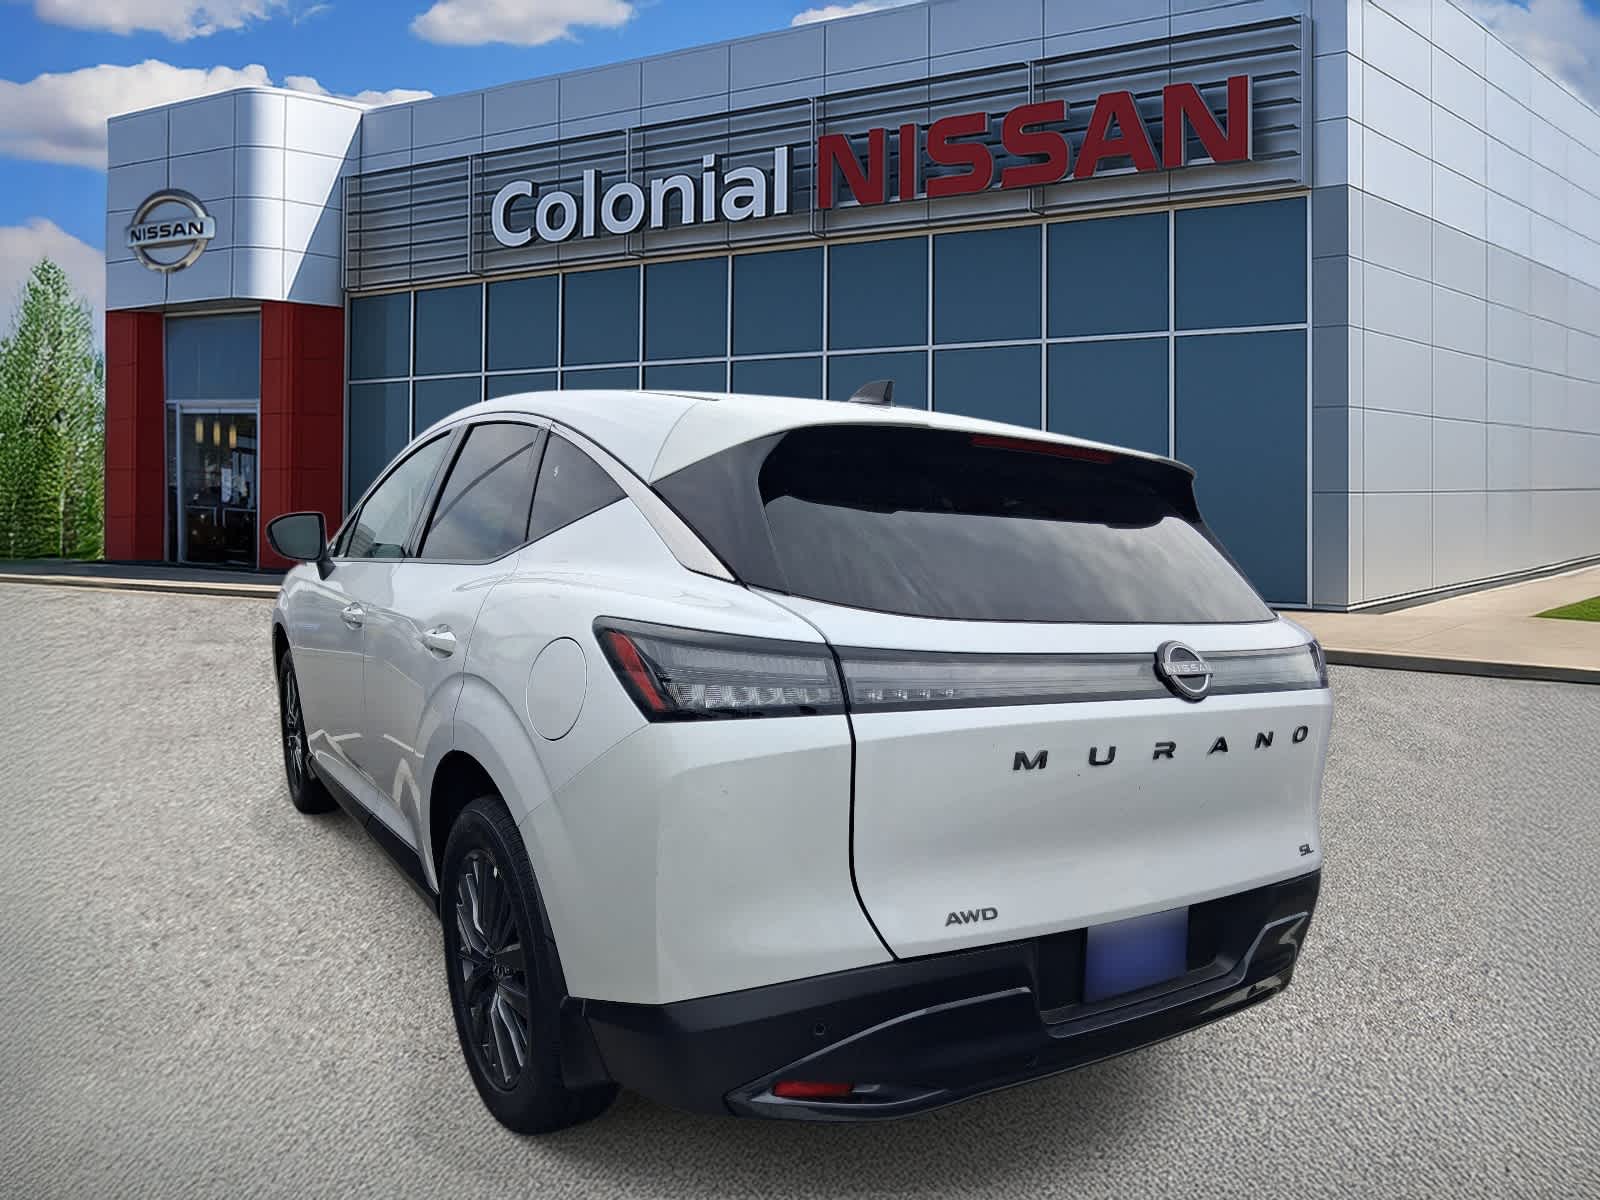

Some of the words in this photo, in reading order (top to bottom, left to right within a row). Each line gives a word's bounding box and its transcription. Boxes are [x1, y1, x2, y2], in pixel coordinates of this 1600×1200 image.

[491, 146, 792, 247] Colonial
[818, 75, 1253, 209] NISSAN
[130, 221, 204, 243] NISSAN
[1012, 725, 1309, 771] MURANO
[1299, 843, 1314, 857] SL
[945, 906, 998, 927] AWD
